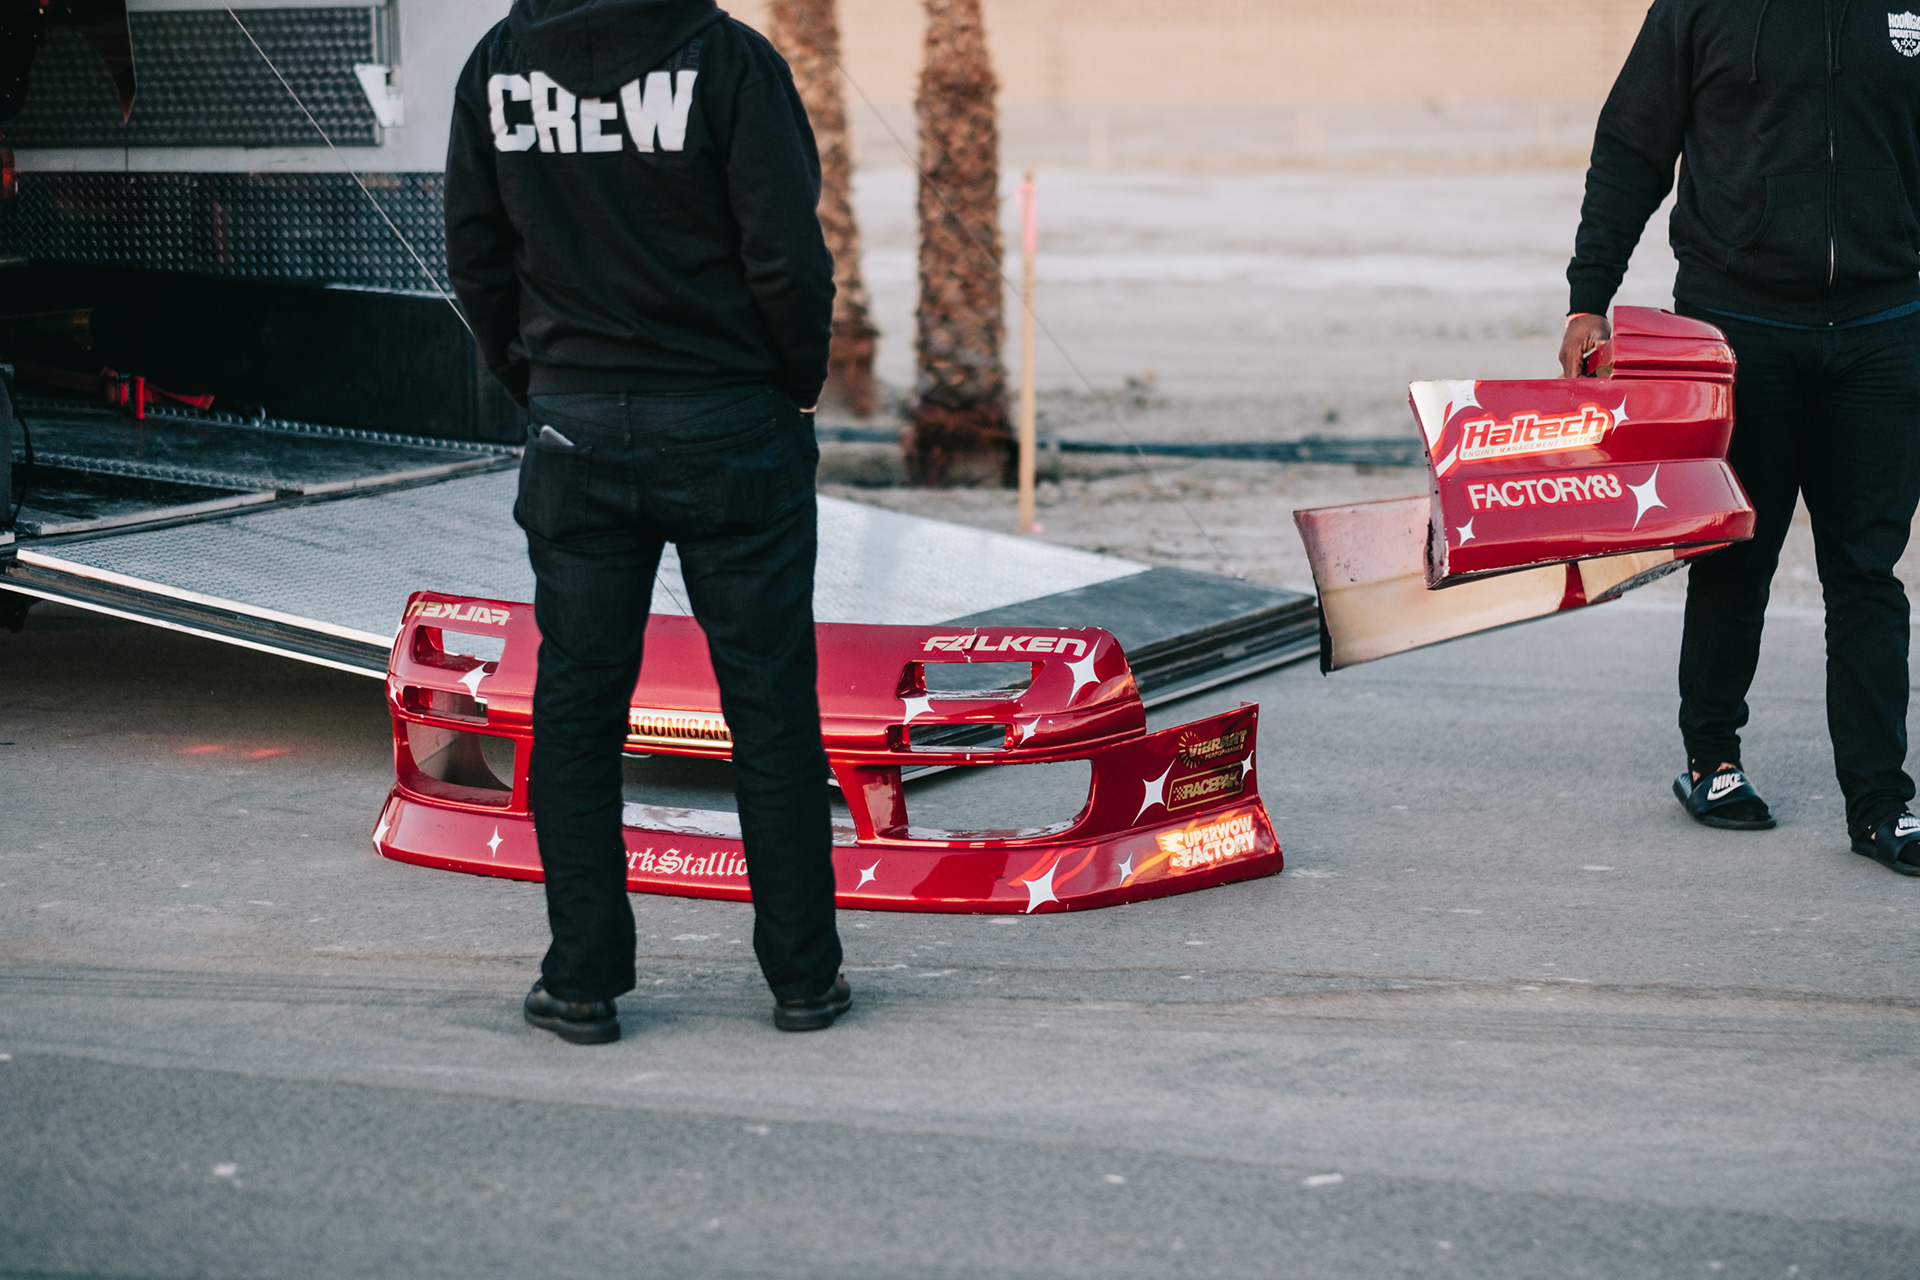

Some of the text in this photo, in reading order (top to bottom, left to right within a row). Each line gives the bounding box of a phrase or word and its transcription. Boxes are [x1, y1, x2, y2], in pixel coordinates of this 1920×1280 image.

[488, 70, 699, 153] CREW
[1464, 409, 1606, 450] Haltech
[1462, 434, 1602, 459] ENGINE MANAGEMENT SYSTEMS
[922, 634, 1087, 657] FALKEN
[1188, 730, 1247, 758] VIBRANT
[1182, 770, 1240, 800] RACEPAK
[1712, 773, 1741, 793] NIKE
[1160, 815, 1252, 852] SUPERWOW
[625, 848, 748, 877] rkStallio
[1171, 830, 1256, 868] FACTORY
